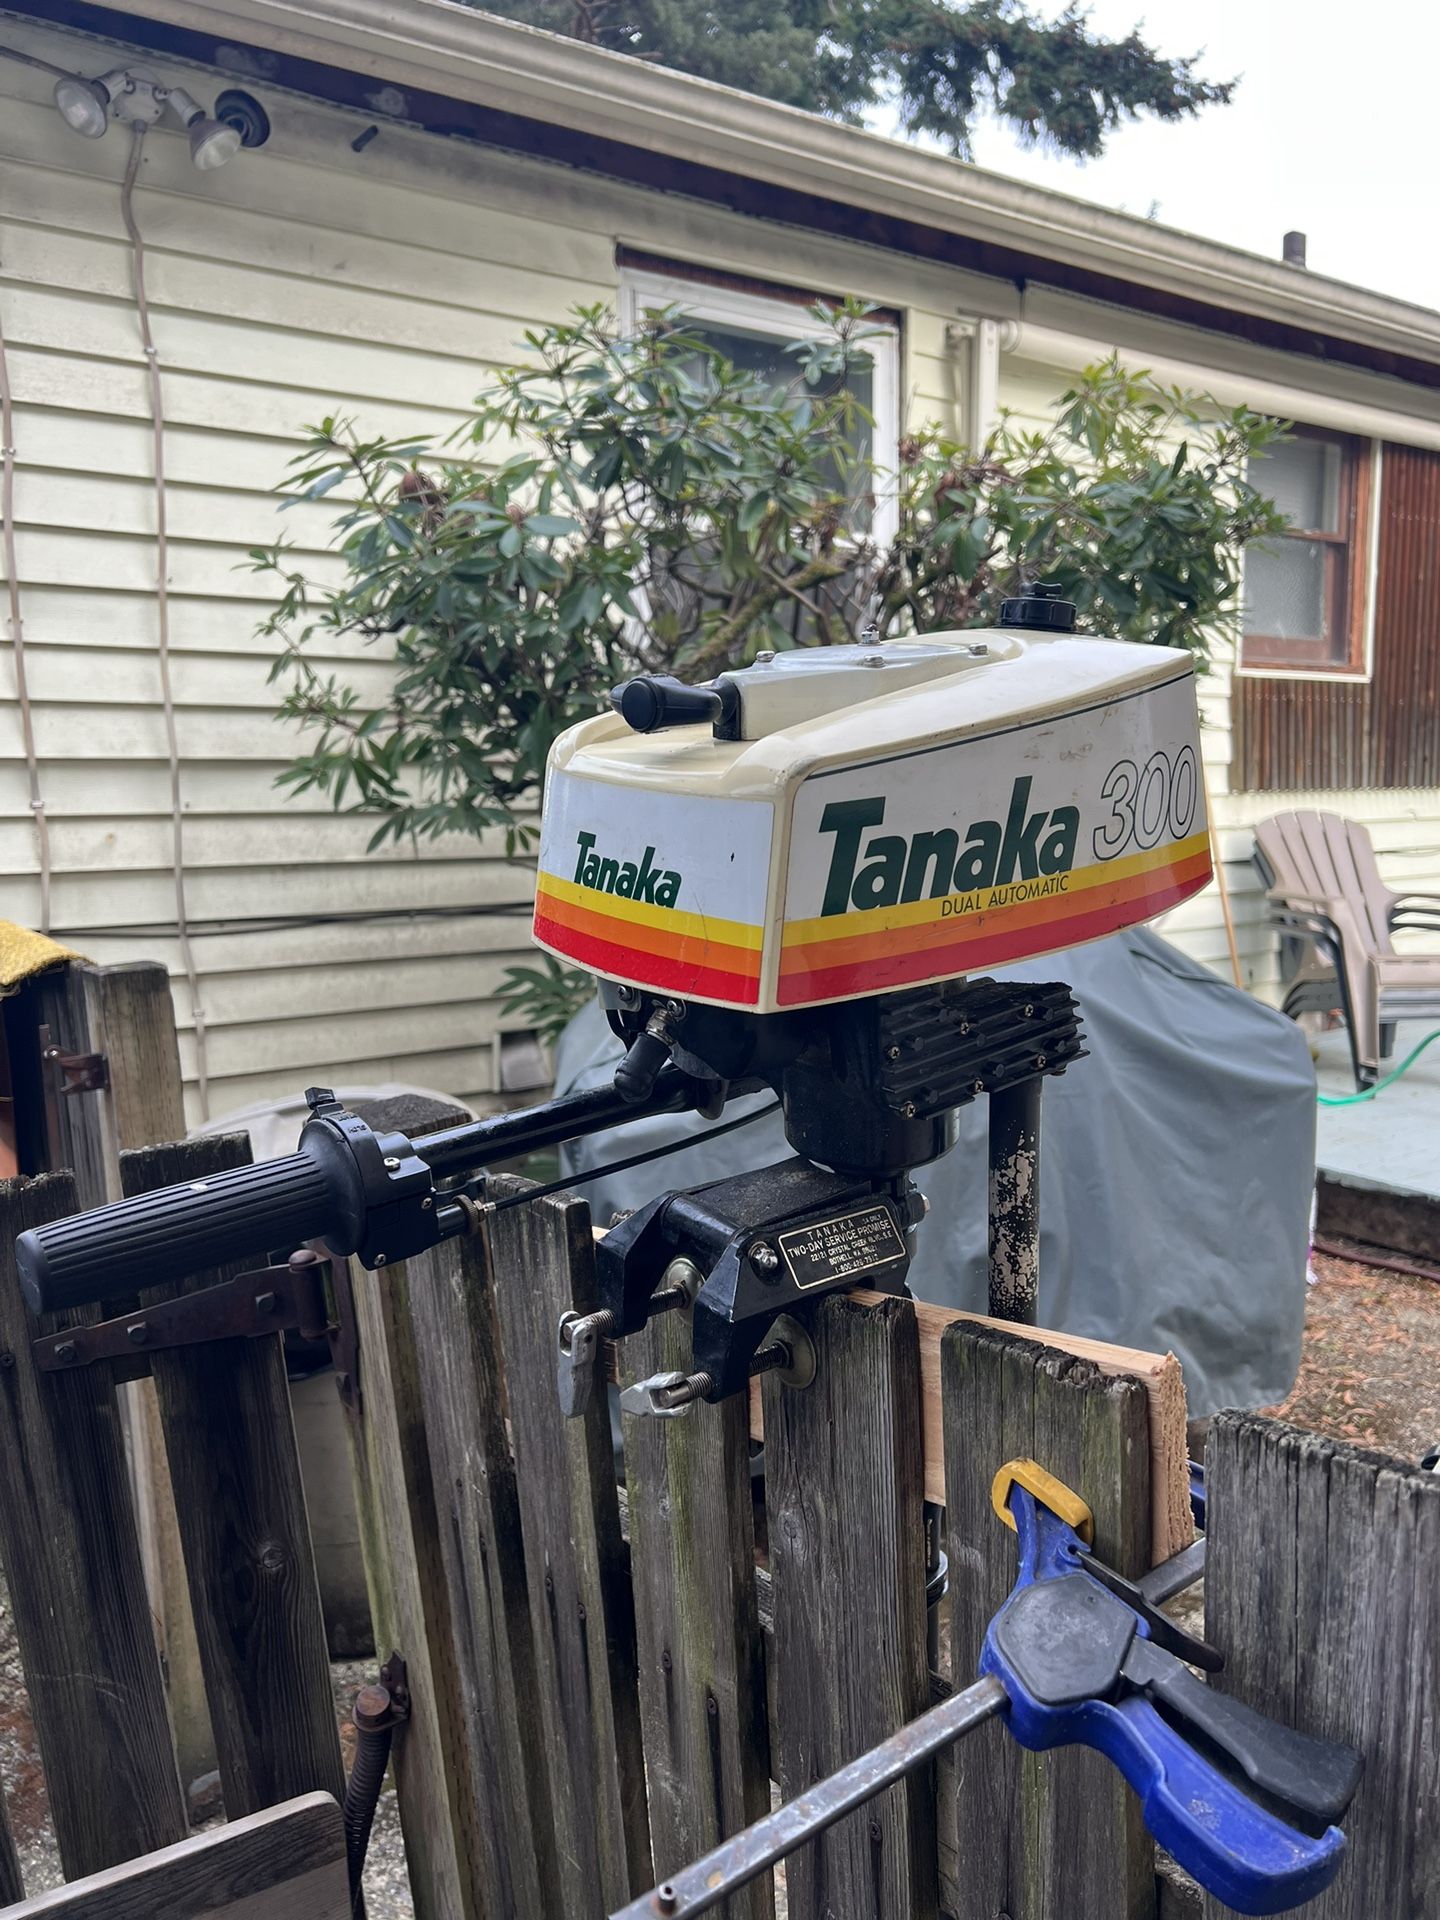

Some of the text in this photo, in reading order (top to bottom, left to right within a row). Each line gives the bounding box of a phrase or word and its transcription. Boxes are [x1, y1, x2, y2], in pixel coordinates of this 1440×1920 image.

[1093, 745, 1198, 861] 300
[818, 776, 1079, 917] Tanaka
[574, 831, 682, 909] Tanaka
[941, 874, 1069, 917] DUAL AUTOMATIC
[787, 1219, 891, 1258] TWO-DAY SERVICE PROMISE
[807, 1219, 854, 1240] TANAKA
[810, 1250, 828, 1262] 22121
[827, 1244, 851, 1257] CRYSTAL
